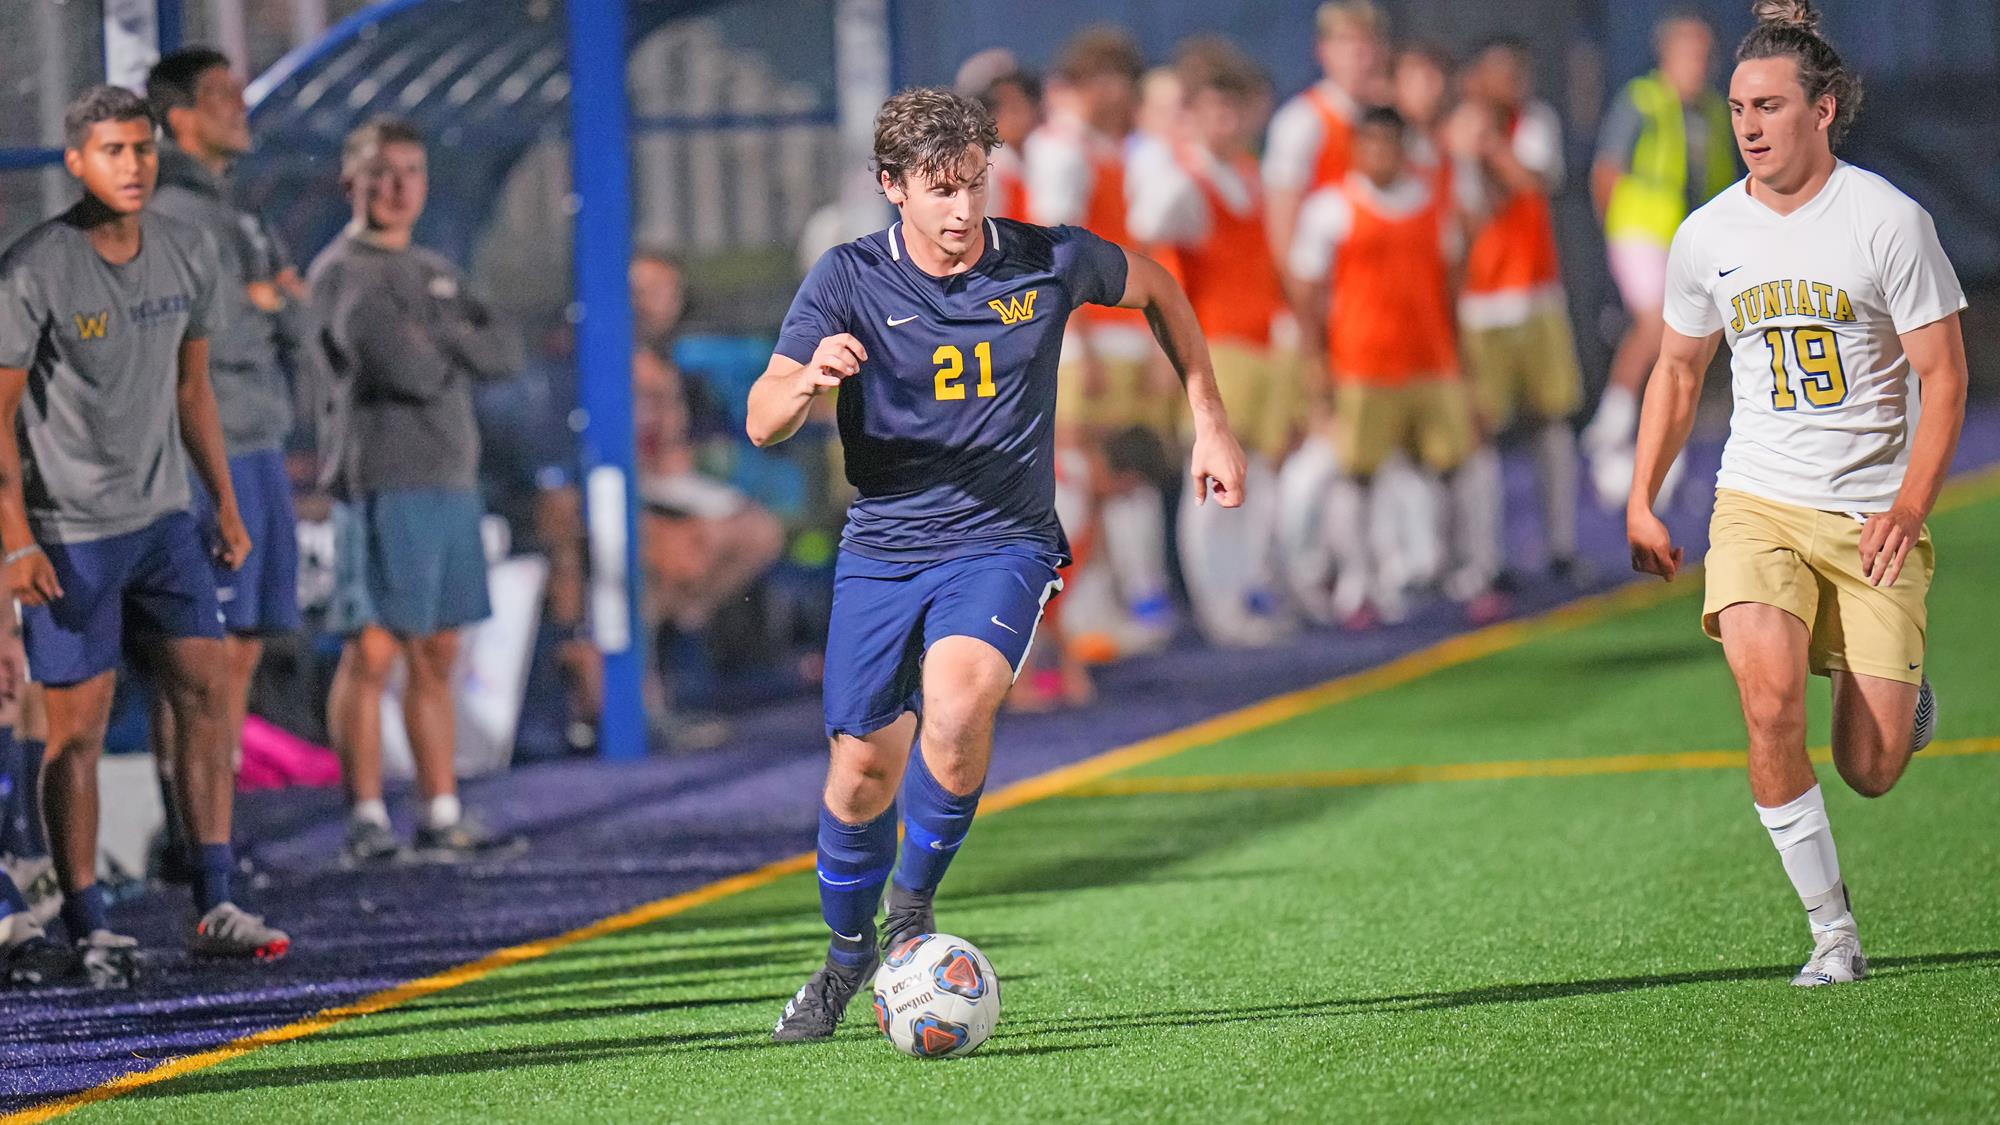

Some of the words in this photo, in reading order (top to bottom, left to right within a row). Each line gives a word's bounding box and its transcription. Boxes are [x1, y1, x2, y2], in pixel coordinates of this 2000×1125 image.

[74, 311, 107, 339] W
[988, 290, 1037, 324] W
[1731, 279, 1857, 332] JUNIATA
[933, 342, 996, 400] 21
[1764, 326, 1848, 411] 19
[896, 992, 933, 1014] Wilson
